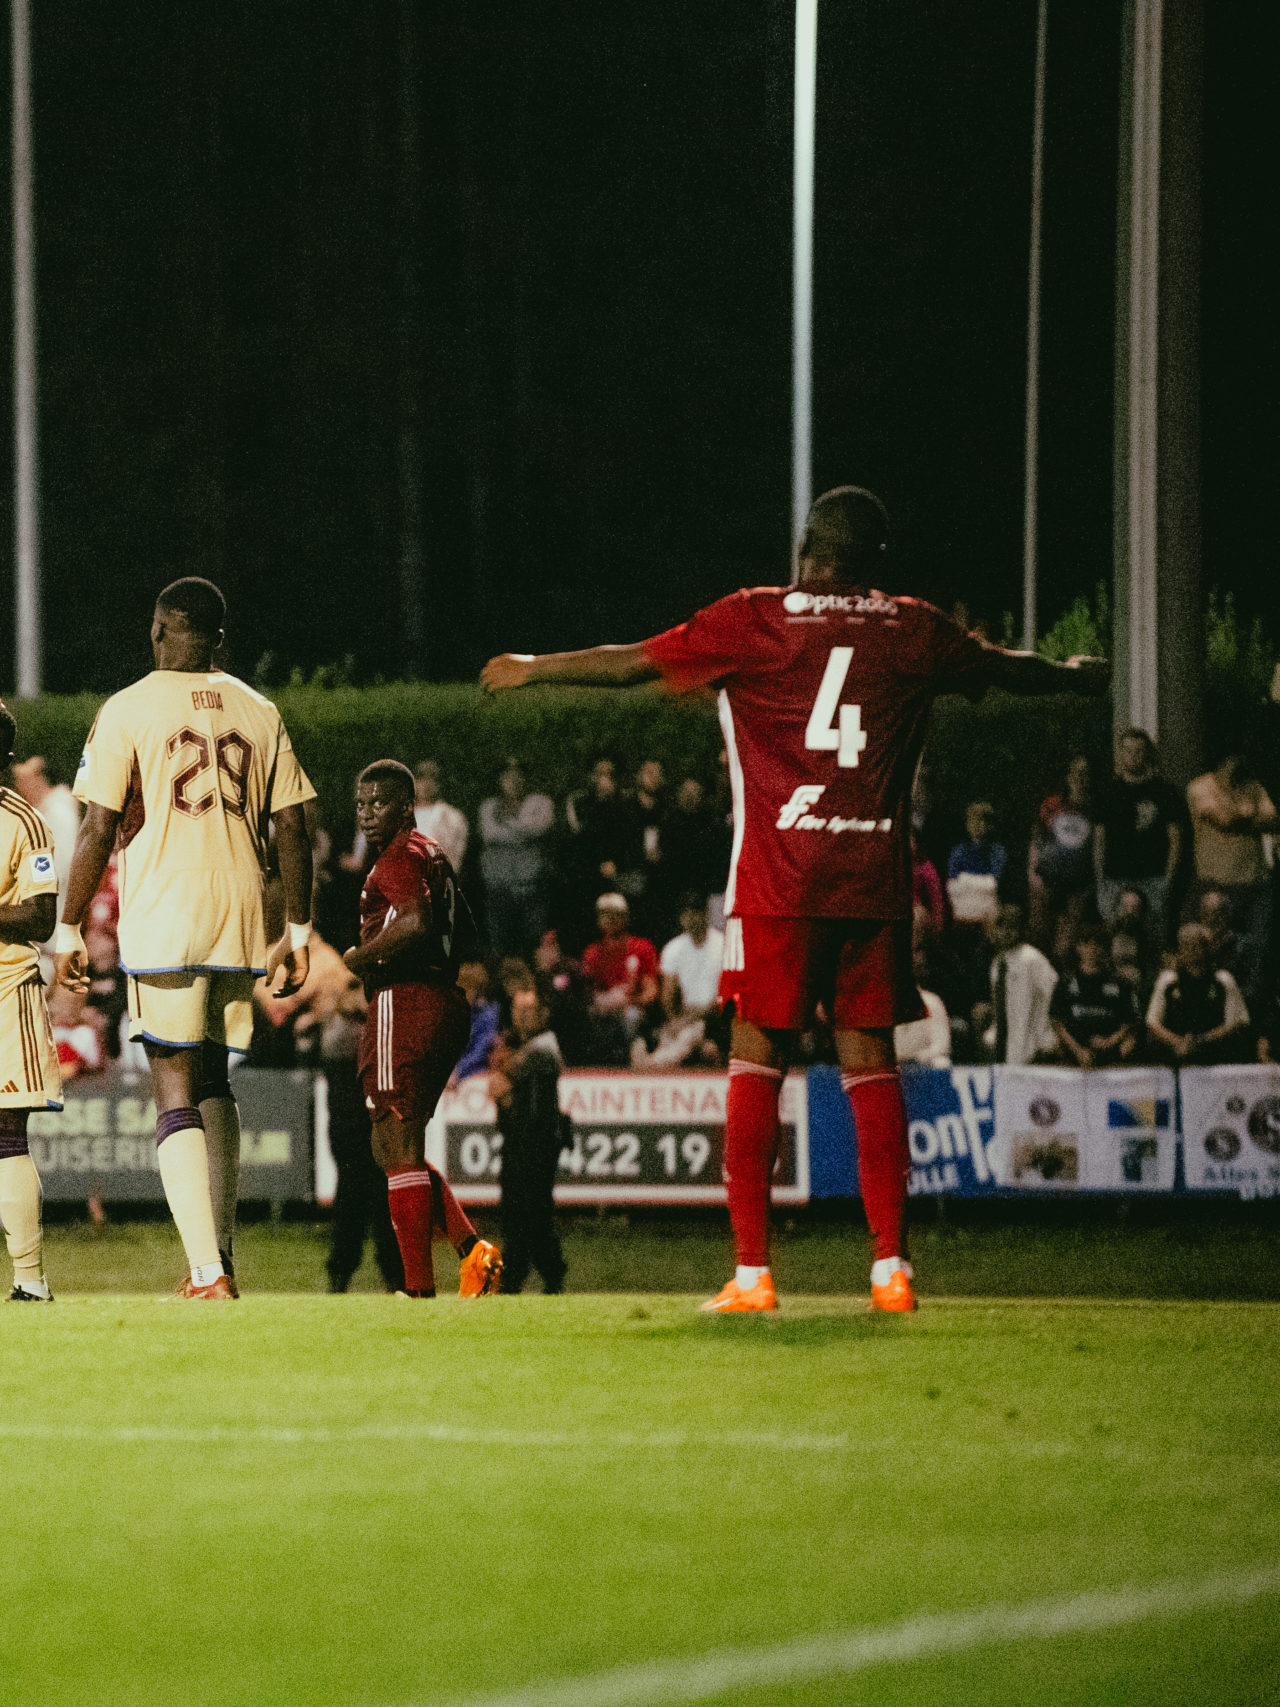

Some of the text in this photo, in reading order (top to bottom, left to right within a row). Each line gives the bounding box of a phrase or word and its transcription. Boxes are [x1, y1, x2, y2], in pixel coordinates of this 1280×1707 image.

[191, 690, 224, 711] BEDIA
[805, 647, 867, 768] 4
[167, 726, 255, 821] 29
[657, 1132, 710, 1176] 19
